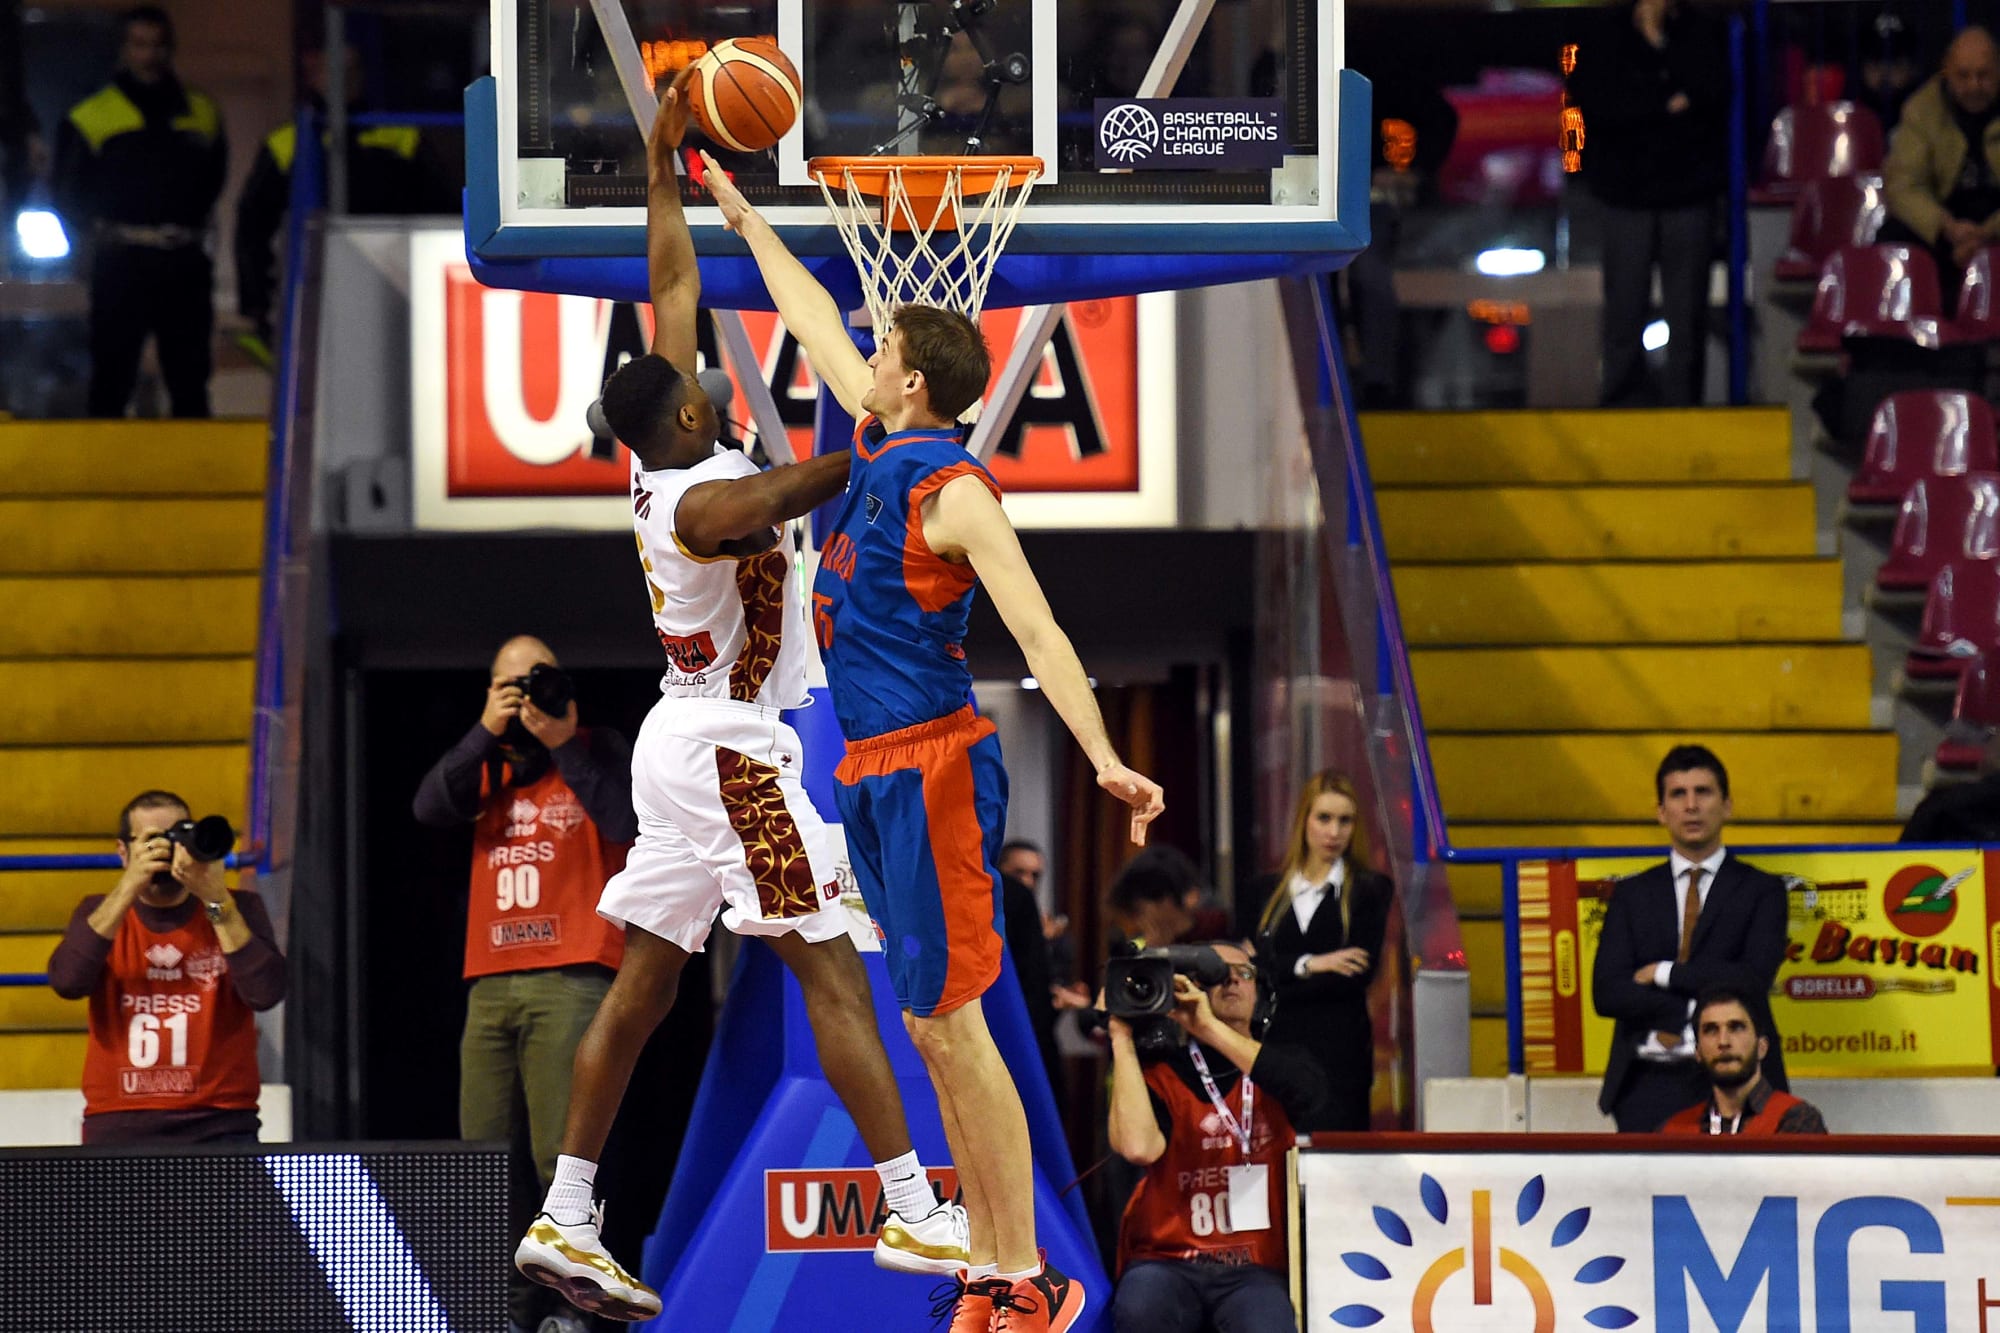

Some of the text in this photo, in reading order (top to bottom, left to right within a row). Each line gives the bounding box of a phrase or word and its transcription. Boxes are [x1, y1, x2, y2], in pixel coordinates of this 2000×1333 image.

[1163, 111, 1265, 125] BASKETBALL
[1163, 126, 1278, 141] CHAMPIONS
[1163, 142, 1225, 155] LEAGUE
[496, 864, 540, 911] 90
[491, 920, 554, 946] UMANA
[1791, 977, 1867, 995] BORELLA
[121, 993, 201, 1014] PRESS
[128, 1012, 189, 1068] 61
[1782, 1030, 1917, 1053] aborella.it
[1177, 1166, 1229, 1191] PRES
[1190, 1192, 1233, 1236] 80
[1651, 1194, 1948, 1333] MG
